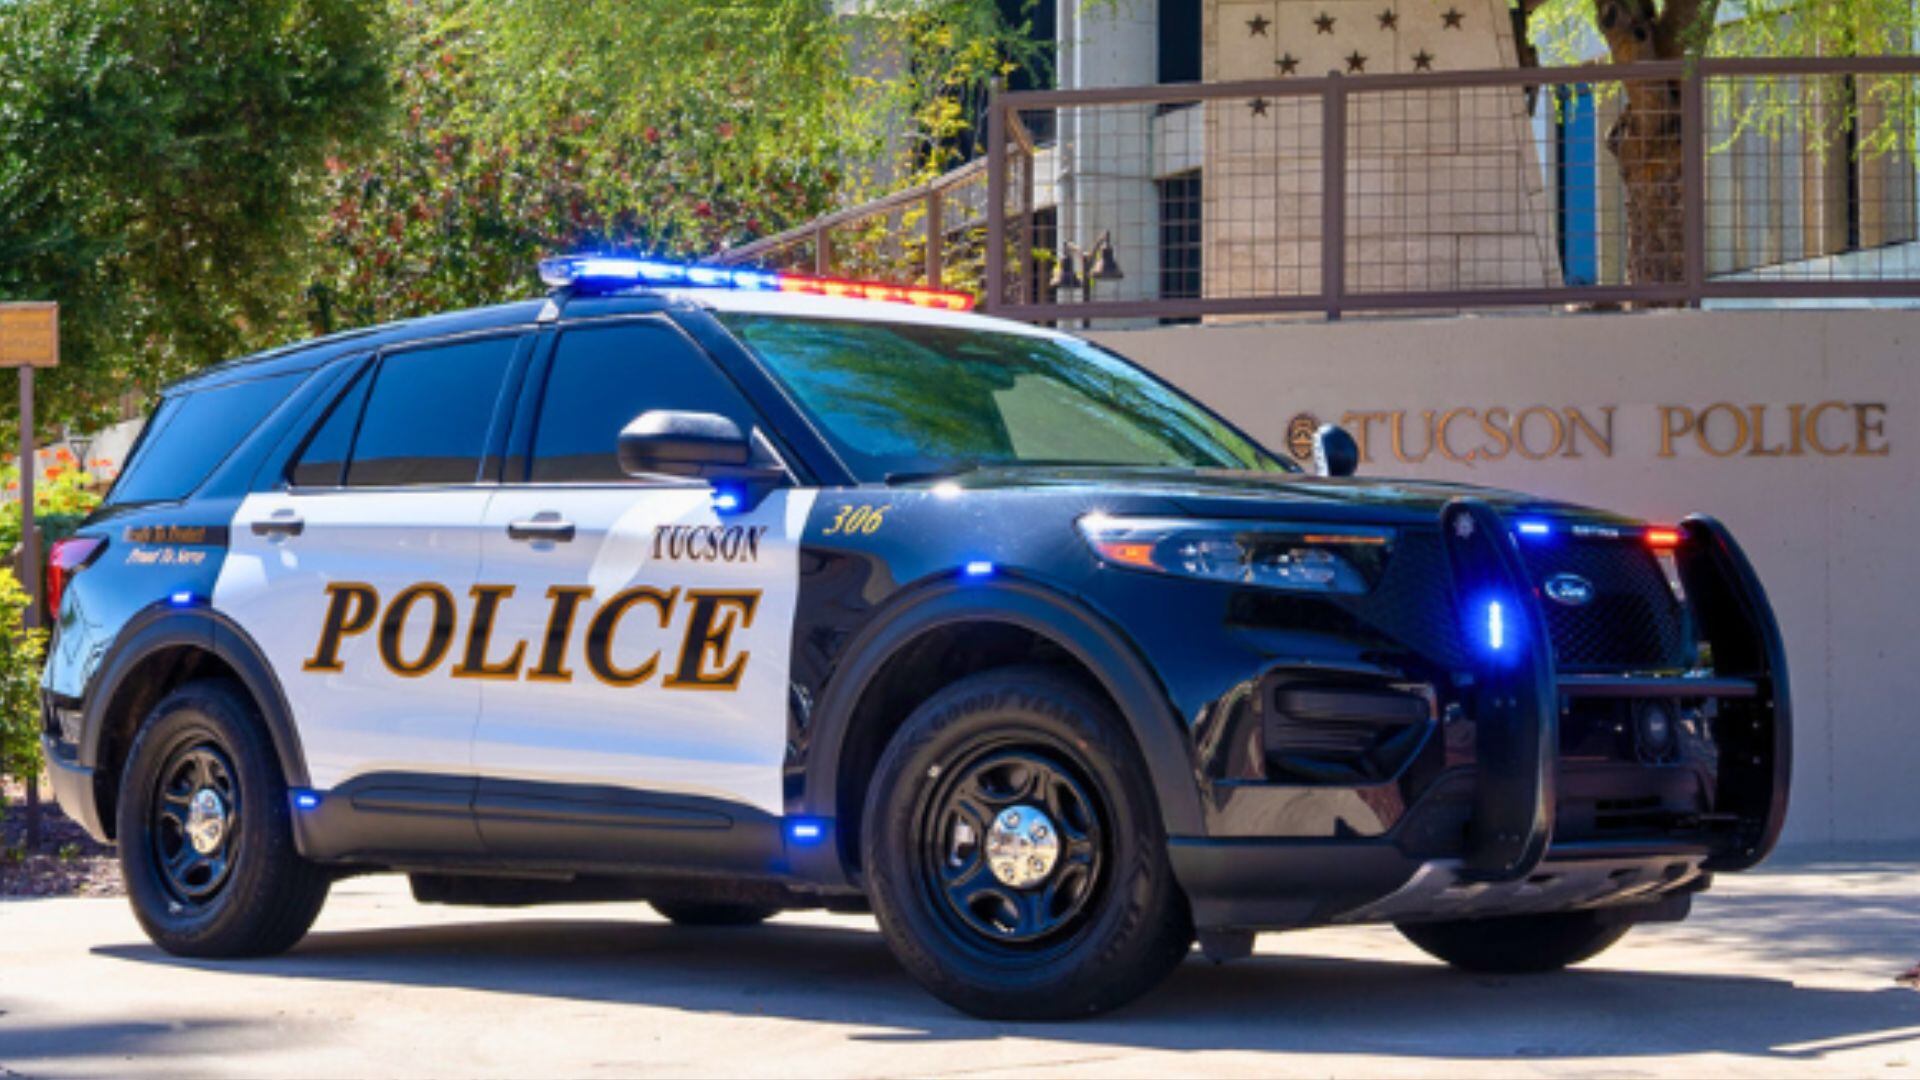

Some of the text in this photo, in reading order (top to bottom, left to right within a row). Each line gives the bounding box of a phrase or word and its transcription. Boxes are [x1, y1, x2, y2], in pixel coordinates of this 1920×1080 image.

[1341, 402, 1890, 464] TUCSON POLICE
[652, 525, 768, 562] TUCSON
[822, 504, 891, 536] 306
[302, 581, 763, 691] POLICE
